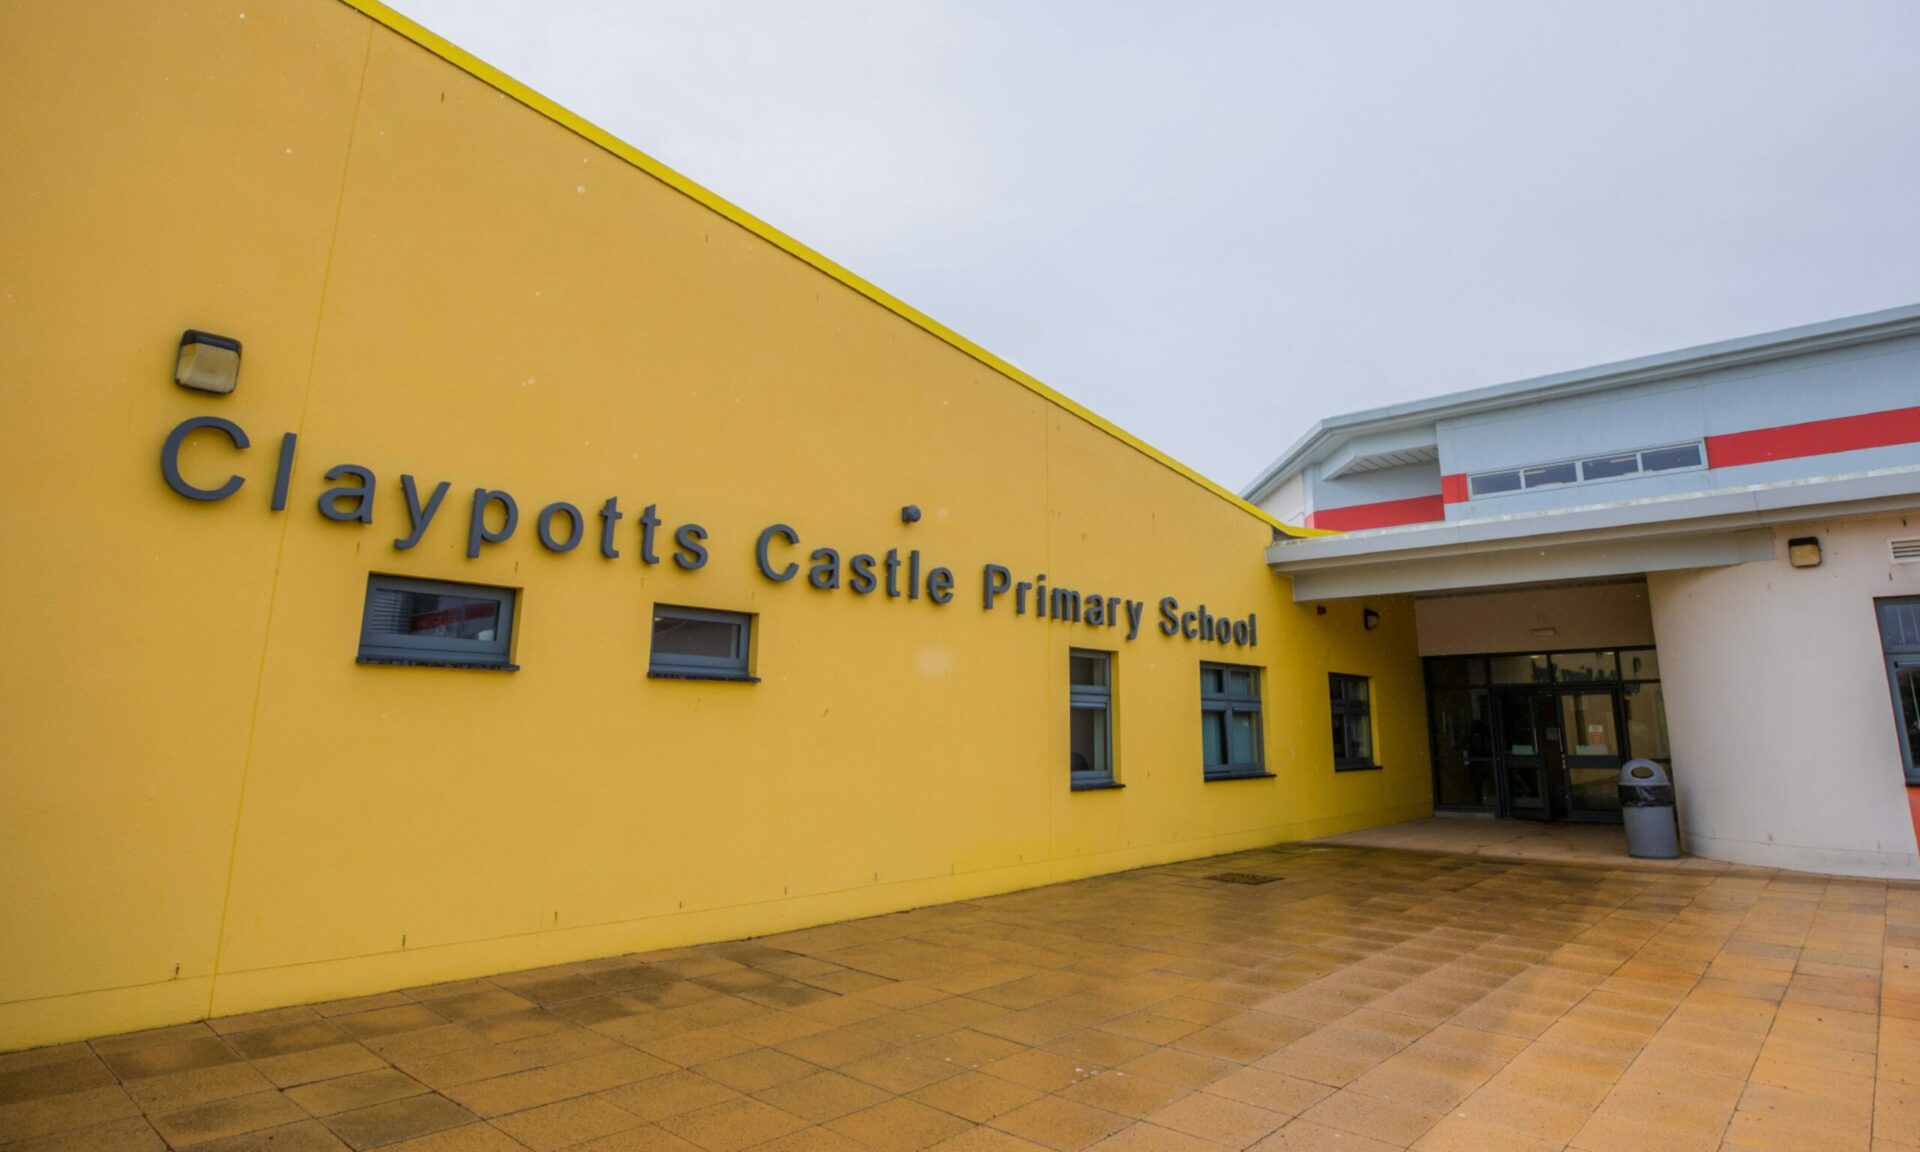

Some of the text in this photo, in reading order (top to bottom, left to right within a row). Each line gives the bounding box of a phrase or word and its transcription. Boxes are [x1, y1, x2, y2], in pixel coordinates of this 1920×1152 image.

[161, 415, 1257, 646] Claypotts Castle Primary School
